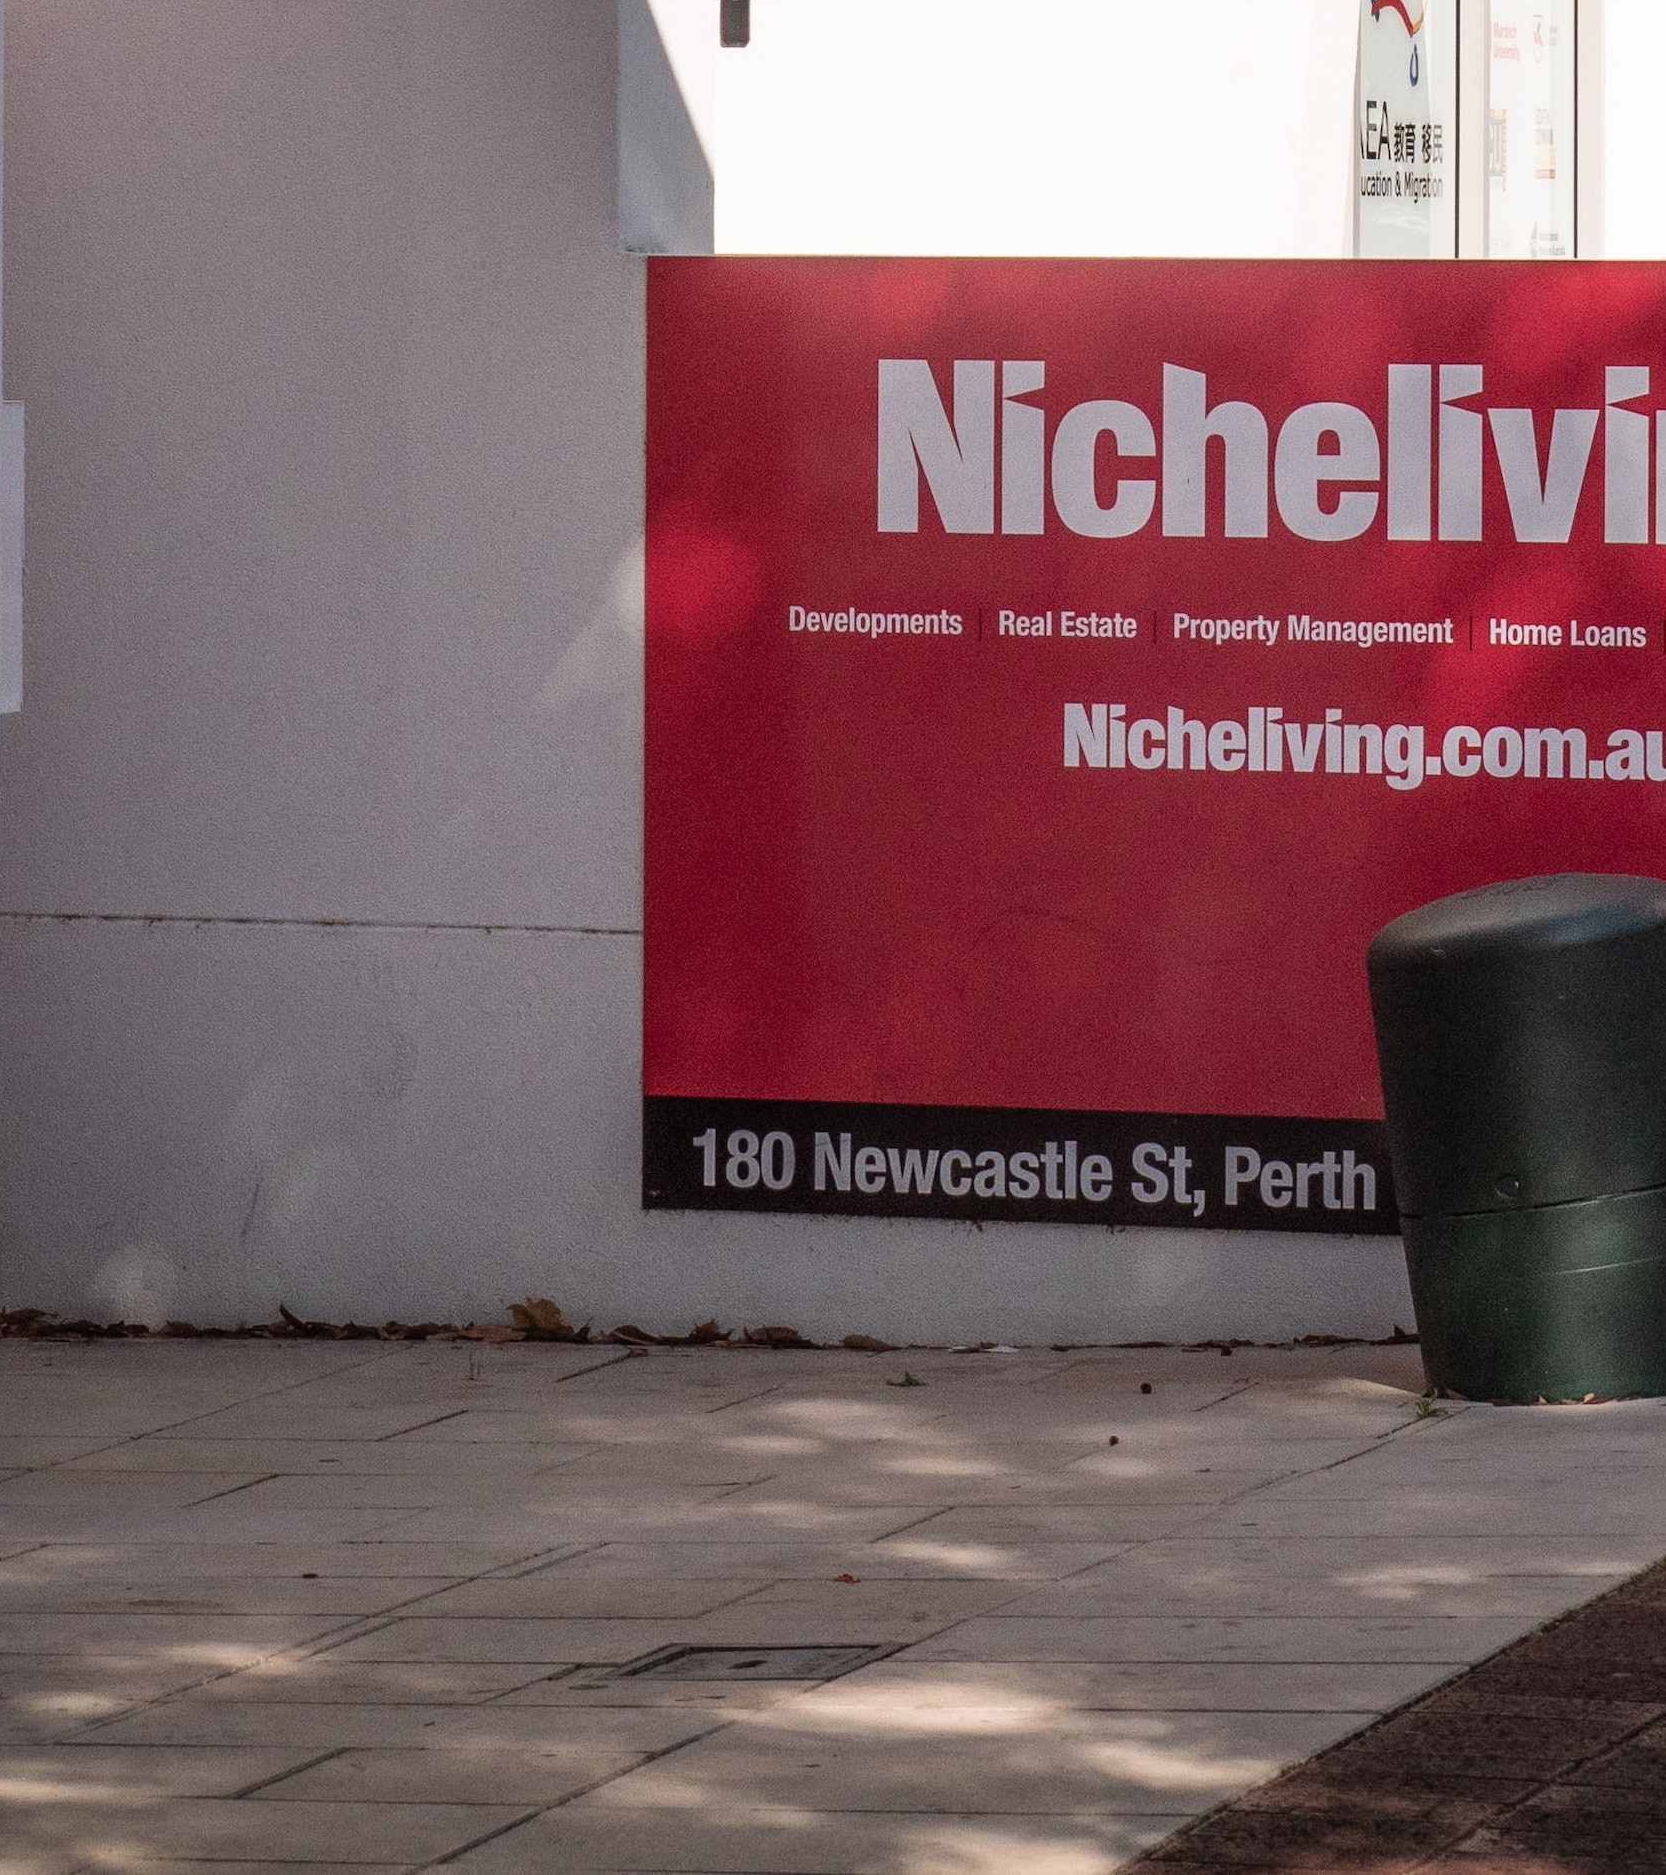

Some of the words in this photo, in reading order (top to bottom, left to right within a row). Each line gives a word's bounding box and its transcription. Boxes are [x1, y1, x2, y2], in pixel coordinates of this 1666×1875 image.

[789, 606, 963, 639] Developments
[998, 610, 1053, 637] Real
[1060, 611, 1138, 639] Estate
[1173, 613, 1280, 647] Property
[1287, 615, 1455, 649] Management
[1489, 618, 1563, 647] Home
[1570, 620, 1647, 648] Loans
[691, 1128, 796, 1193] 180
[813, 1133, 1114, 1202] Newcastle
[1130, 1142, 1206, 1218] St,
[1224, 1145, 1376, 1211] Perth
